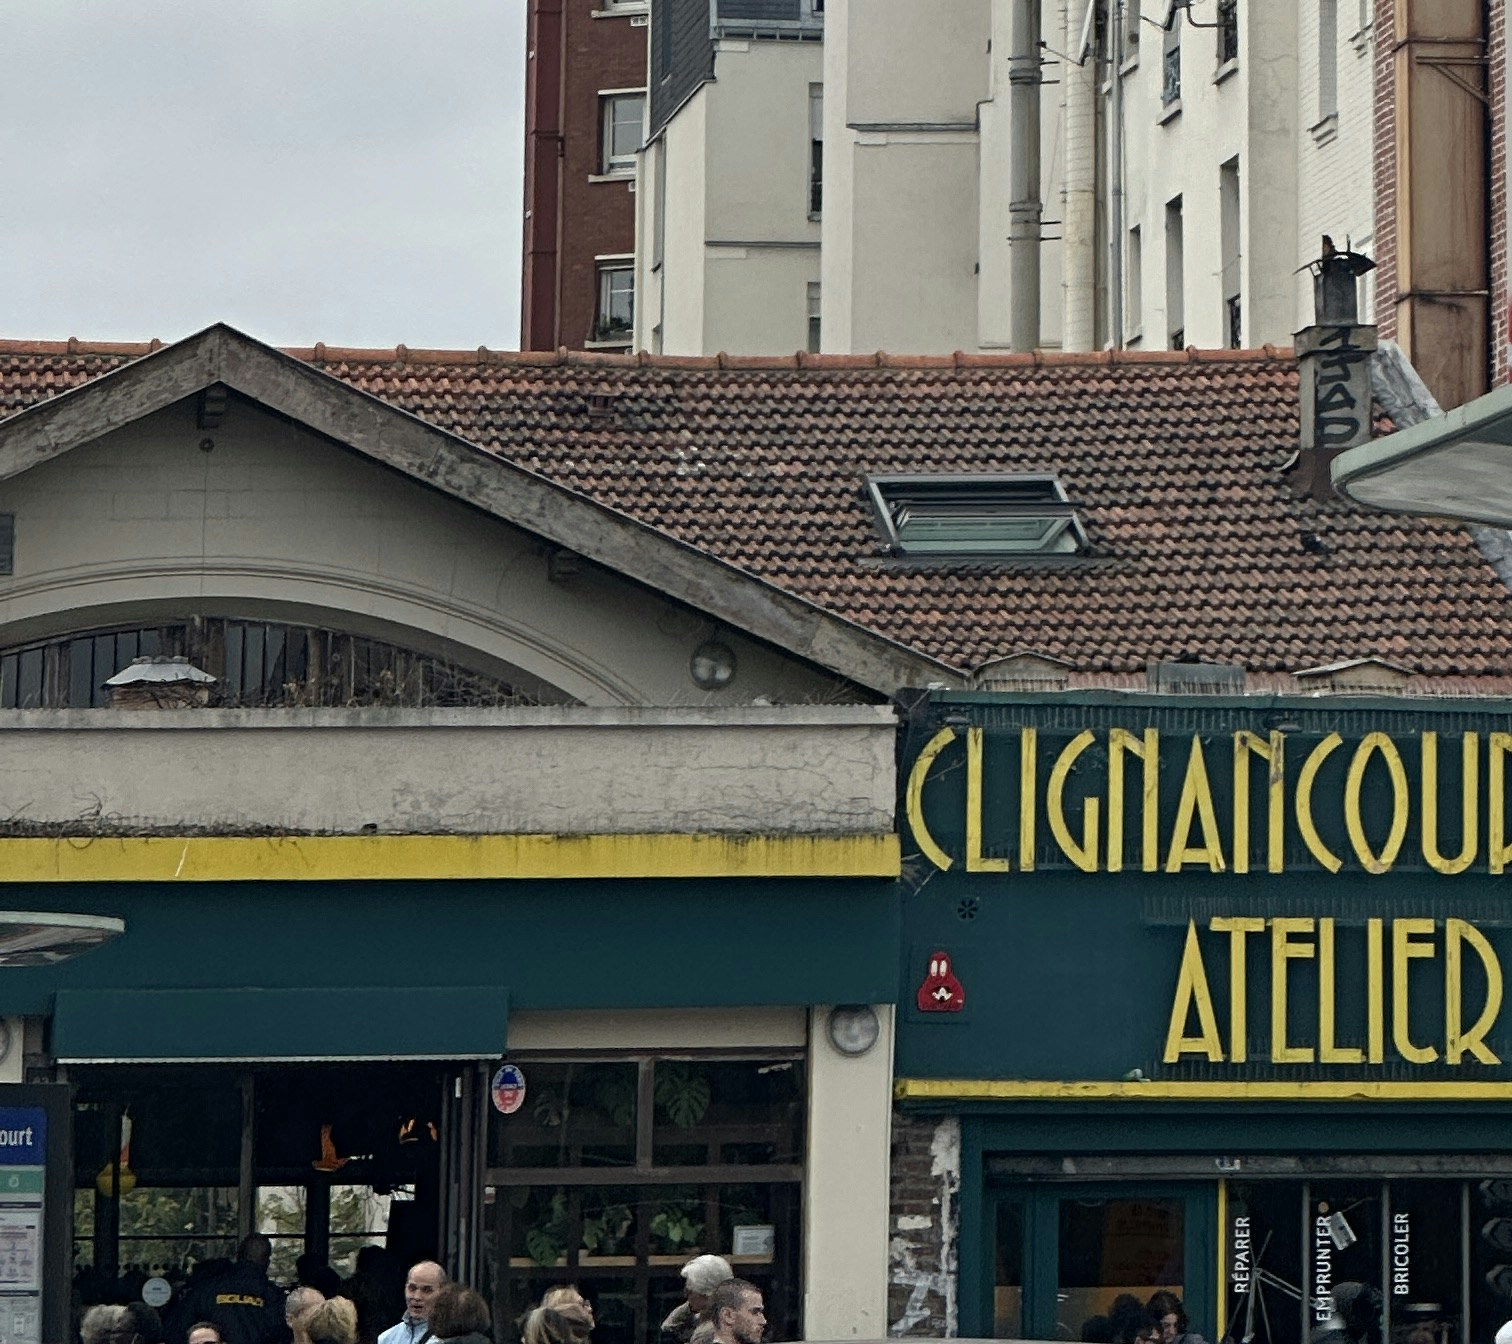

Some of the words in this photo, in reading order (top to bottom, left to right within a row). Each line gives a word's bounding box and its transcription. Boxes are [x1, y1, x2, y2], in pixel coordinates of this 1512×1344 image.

[1163, 917, 1503, 1064] ATELIER
[1231, 1217, 1251, 1293] RÉPARER
[1316, 1215, 1333, 1321] EMPRUNTER
[1393, 1213, 1410, 1295] BRICOLER
